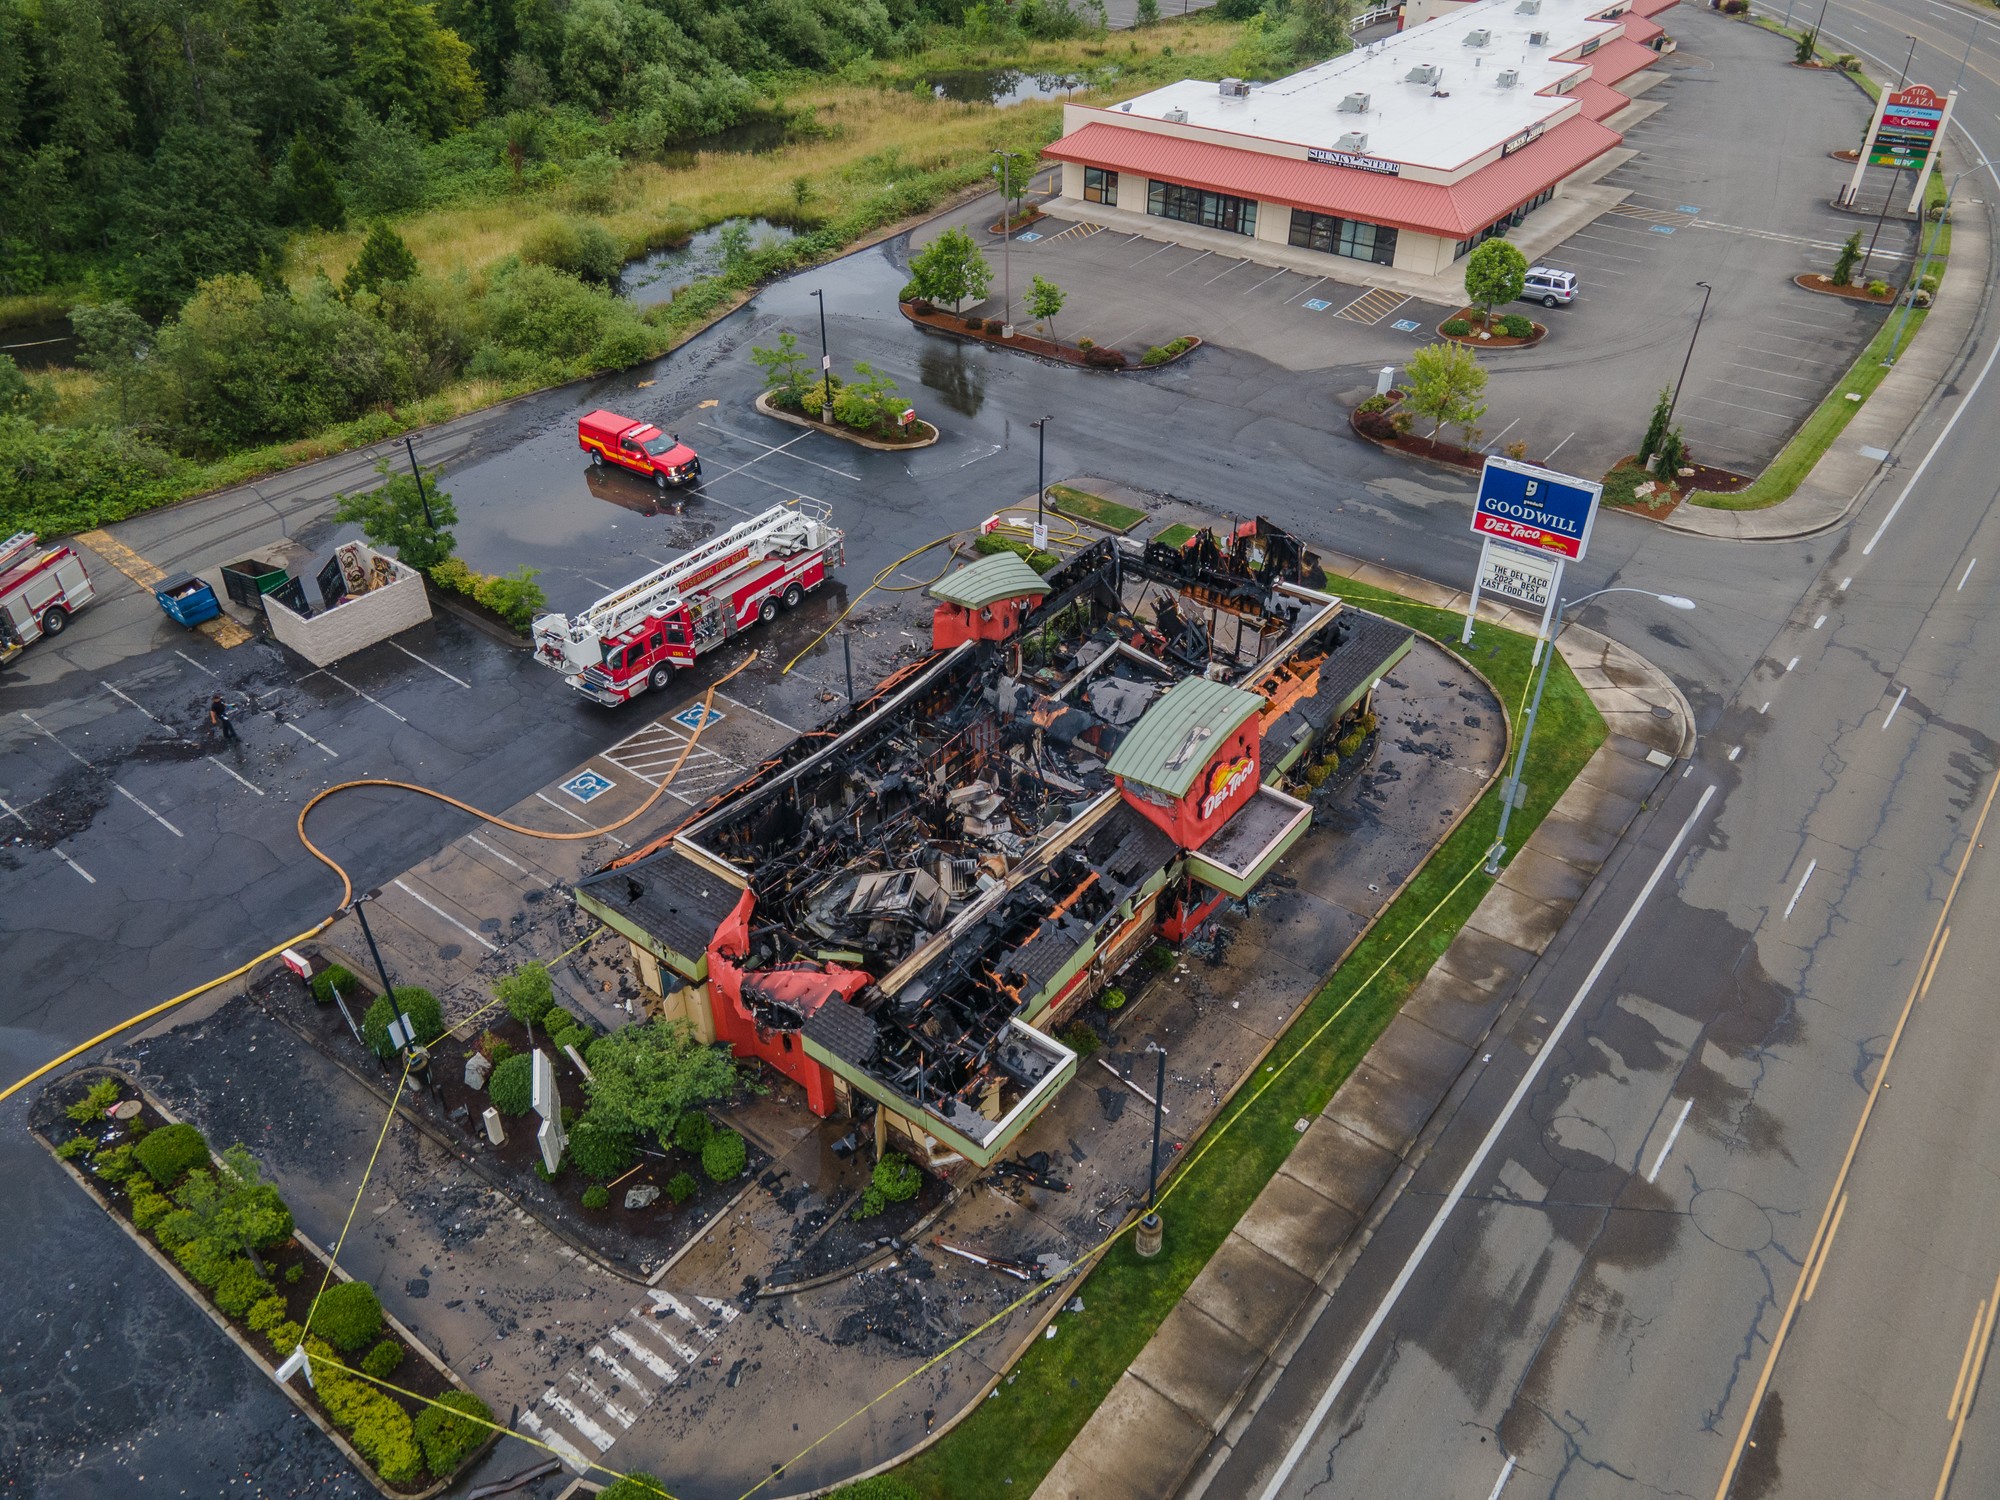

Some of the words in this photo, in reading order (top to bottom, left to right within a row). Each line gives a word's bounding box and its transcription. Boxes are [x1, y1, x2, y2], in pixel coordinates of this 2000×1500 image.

[1900, 95, 1934, 107] PLAZA
[1309, 149, 1355, 164] SPUNKY
[1363, 158, 1399, 172] STEER
[1878, 156, 1915, 166] SUBWAY
[1485, 498, 1577, 533] GOODWILL
[1484, 518, 1510, 533] DEL
[1510, 523, 1540, 539] TACO
[680, 568, 714, 591] ROSEBURG
[715, 560, 730, 573] FIRE
[731, 549, 748, 563] DEPT
[1494, 564, 1508, 575] THE
[1510, 569, 1524, 580] DEL
[1528, 575, 1548, 588] TACO
[1481, 577, 1501, 590] FAST
[1503, 584, 1522, 596] FOOD
[1526, 591, 1546, 604] TACO
[1494, 573, 1513, 585] 2022
[1521, 581, 1540, 594] BEST
[1203, 786, 1229, 819] DEL
[1228, 760, 1254, 797] TACO
